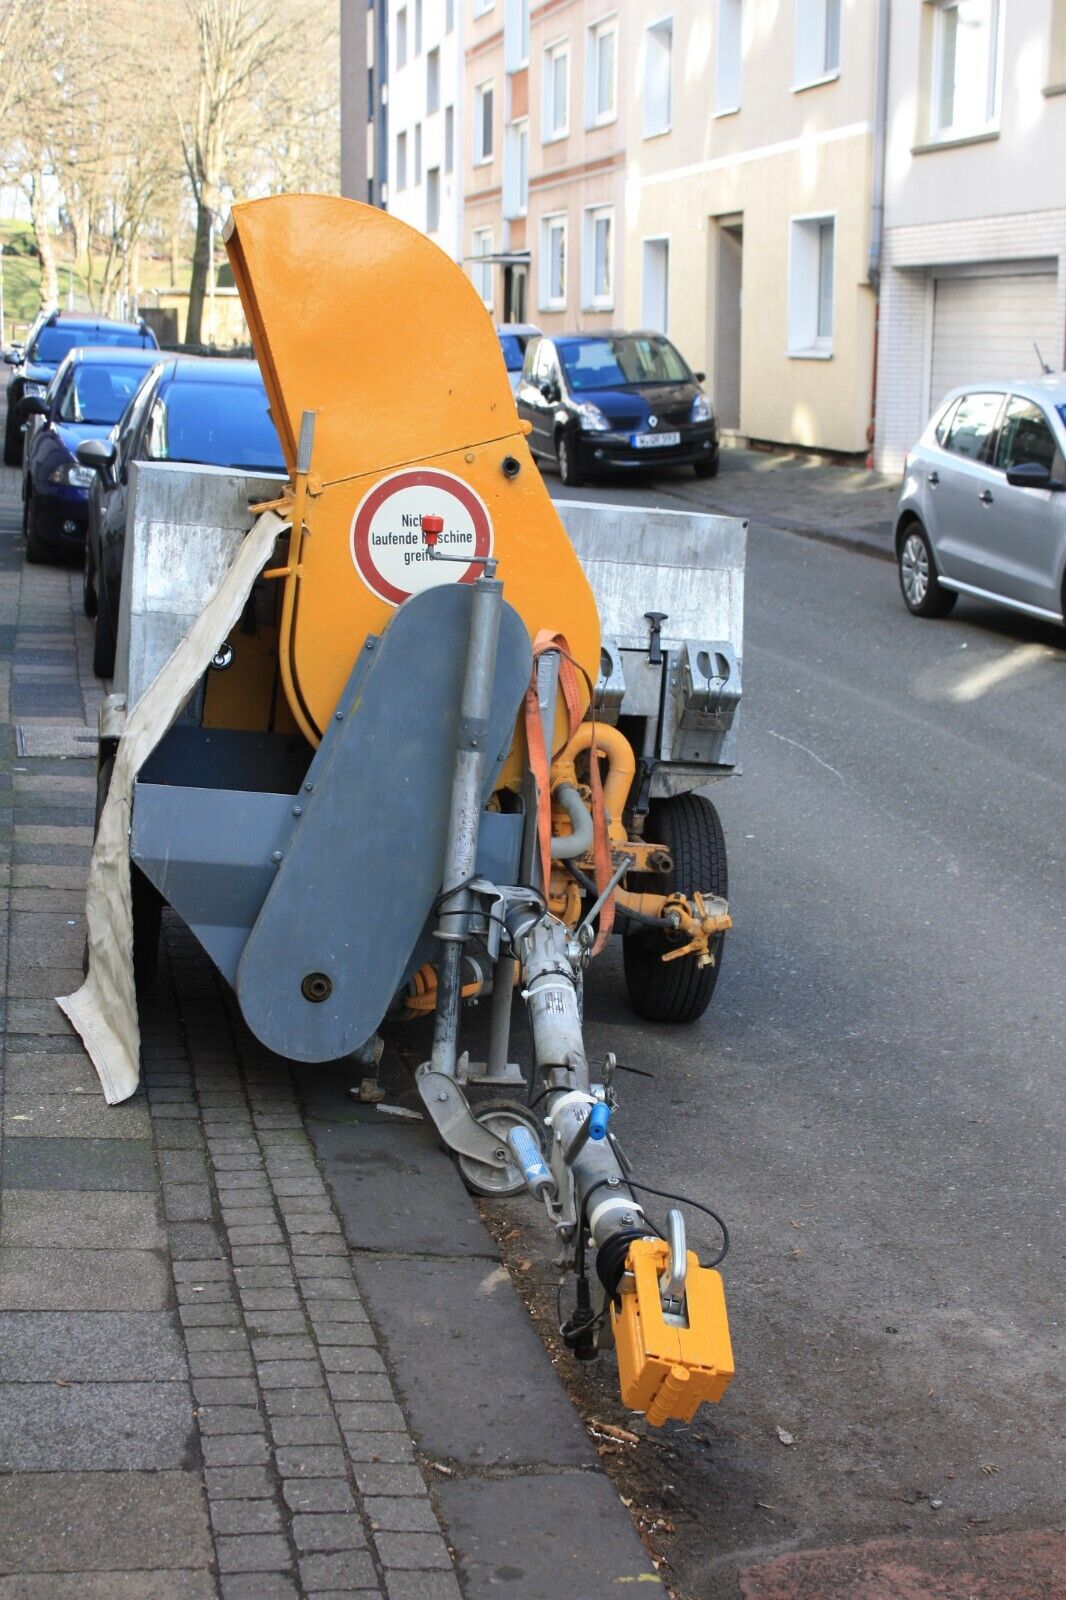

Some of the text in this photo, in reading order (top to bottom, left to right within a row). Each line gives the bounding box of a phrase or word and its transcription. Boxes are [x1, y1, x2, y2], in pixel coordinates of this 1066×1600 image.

[402, 514, 425, 527] Nic
[372, 531, 472, 545] laufende schine
